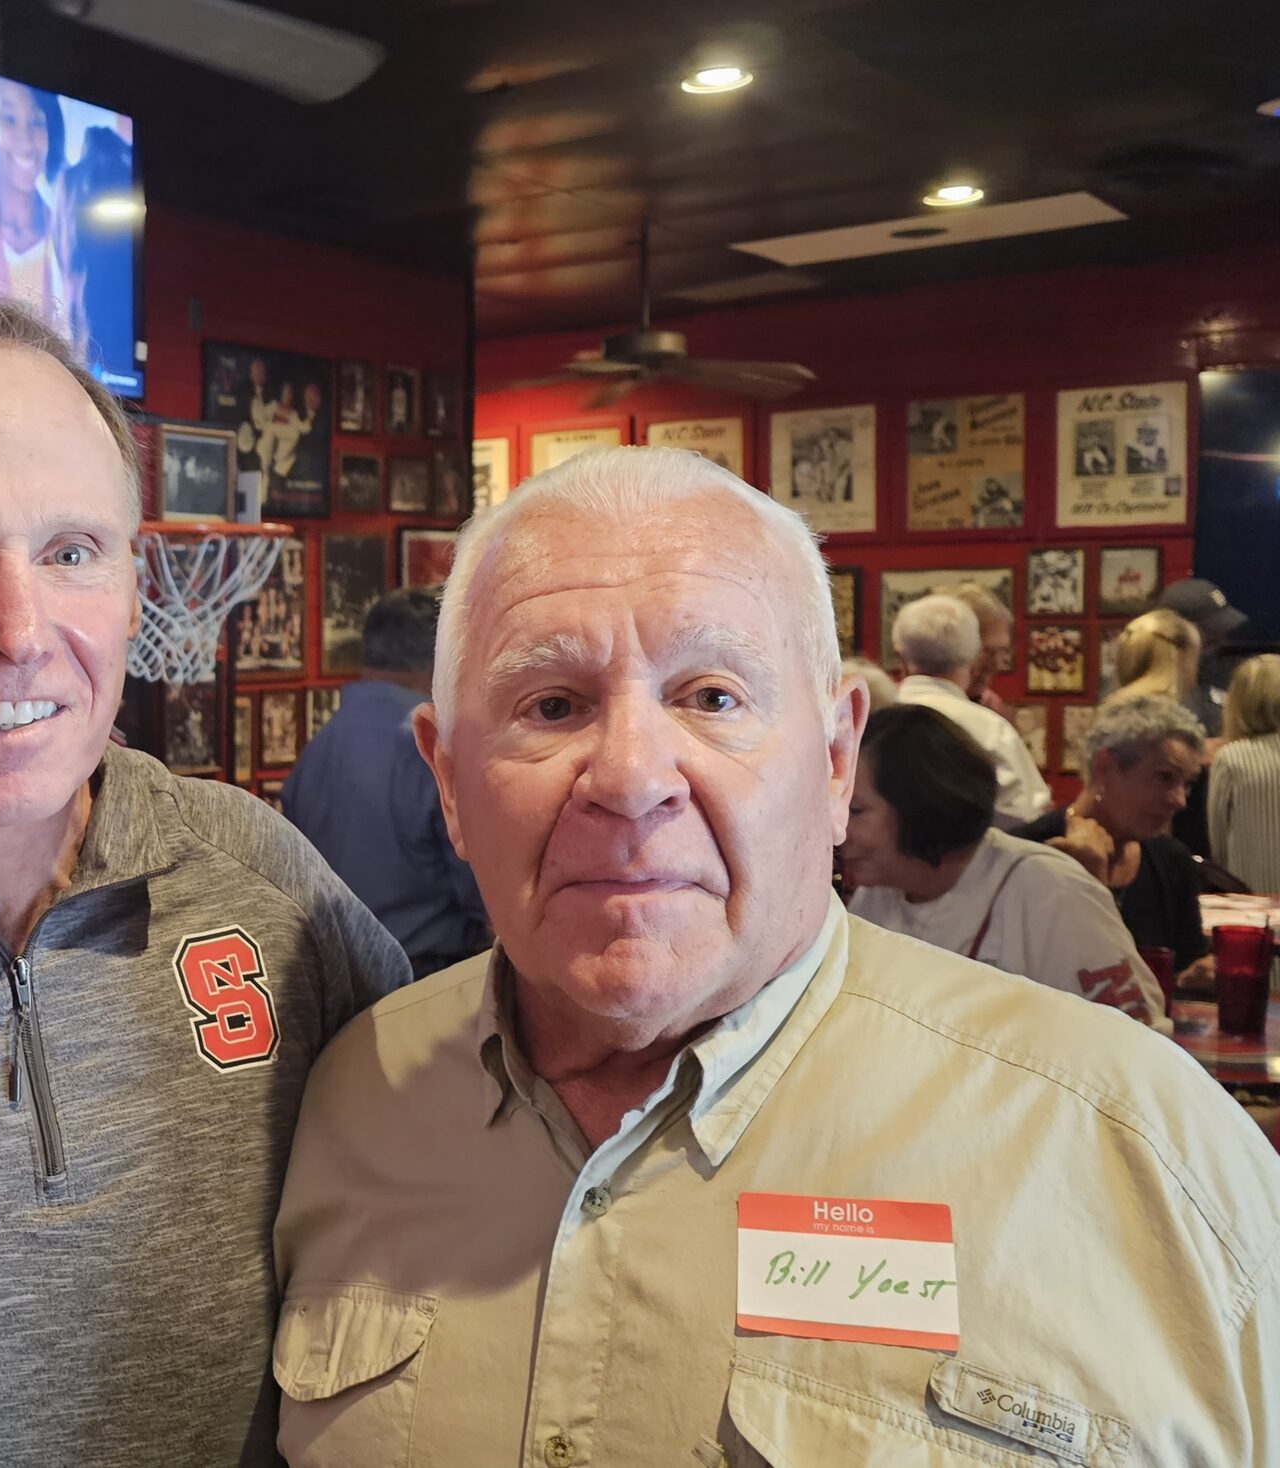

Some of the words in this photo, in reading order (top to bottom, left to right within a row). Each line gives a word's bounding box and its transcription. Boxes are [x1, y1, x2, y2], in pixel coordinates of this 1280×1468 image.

[812, 1200, 874, 1223] Hello
[813, 1222, 829, 1233] my
[832, 1223, 864, 1233] name
[866, 1225, 875, 1235] is
[765, 1250, 831, 1287] Bill
[997, 1394, 1076, 1435] Columbia
[1022, 1420, 1073, 1443] PFG
